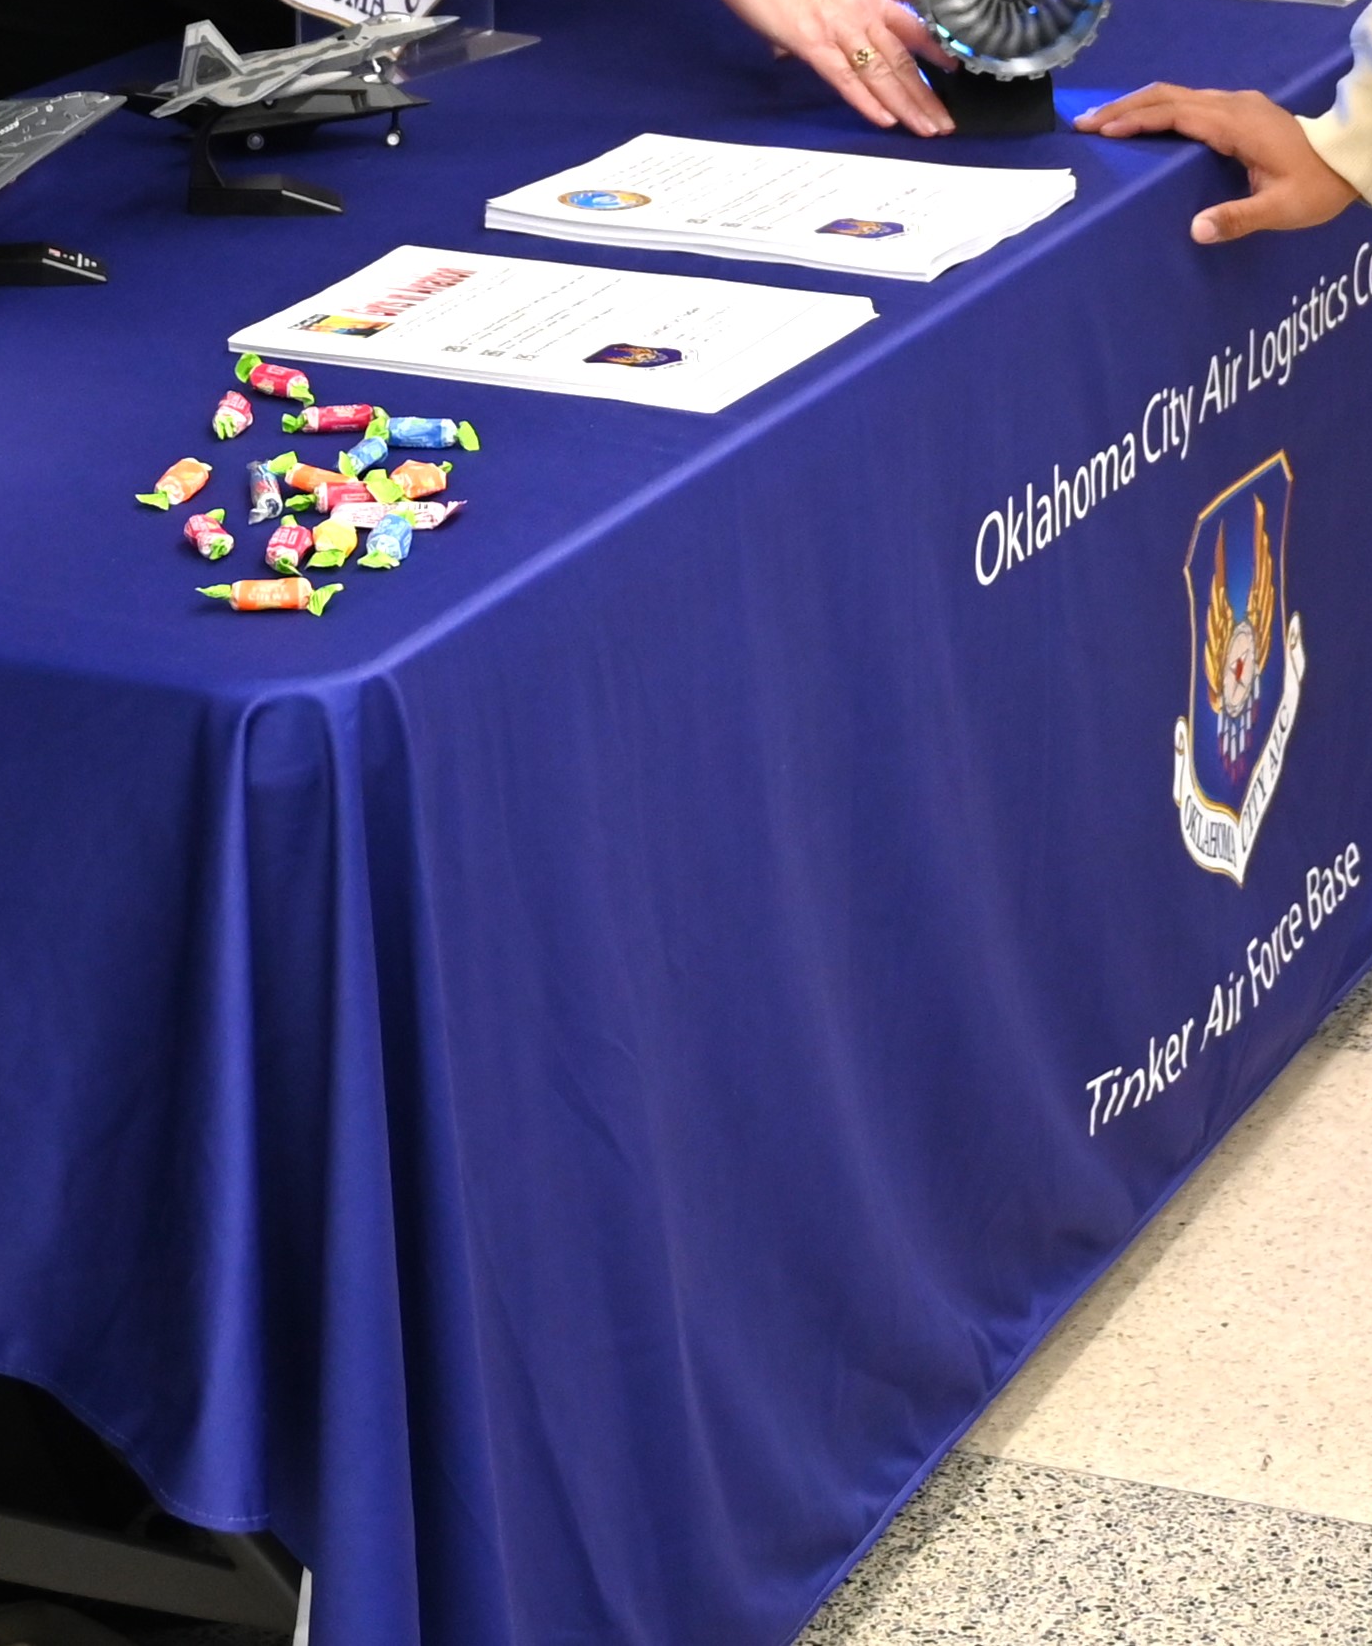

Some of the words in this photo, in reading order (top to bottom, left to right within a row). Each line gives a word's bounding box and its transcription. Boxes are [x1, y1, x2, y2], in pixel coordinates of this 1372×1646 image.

[974, 431, 1136, 587] Oklahoma
[1142, 385, 1194, 461] City
[1198, 347, 1244, 424] Air
[1247, 275, 1349, 391] Logistics
[1184, 794, 1238, 868] OKLAHOMA
[1241, 765, 1267, 853] CITY
[1269, 704, 1290, 781] ALC
[1085, 1018, 1195, 1138] Tinker
[1200, 973, 1245, 1053] Air
[1246, 902, 1302, 1009] Force
[1306, 841, 1361, 931] Base
